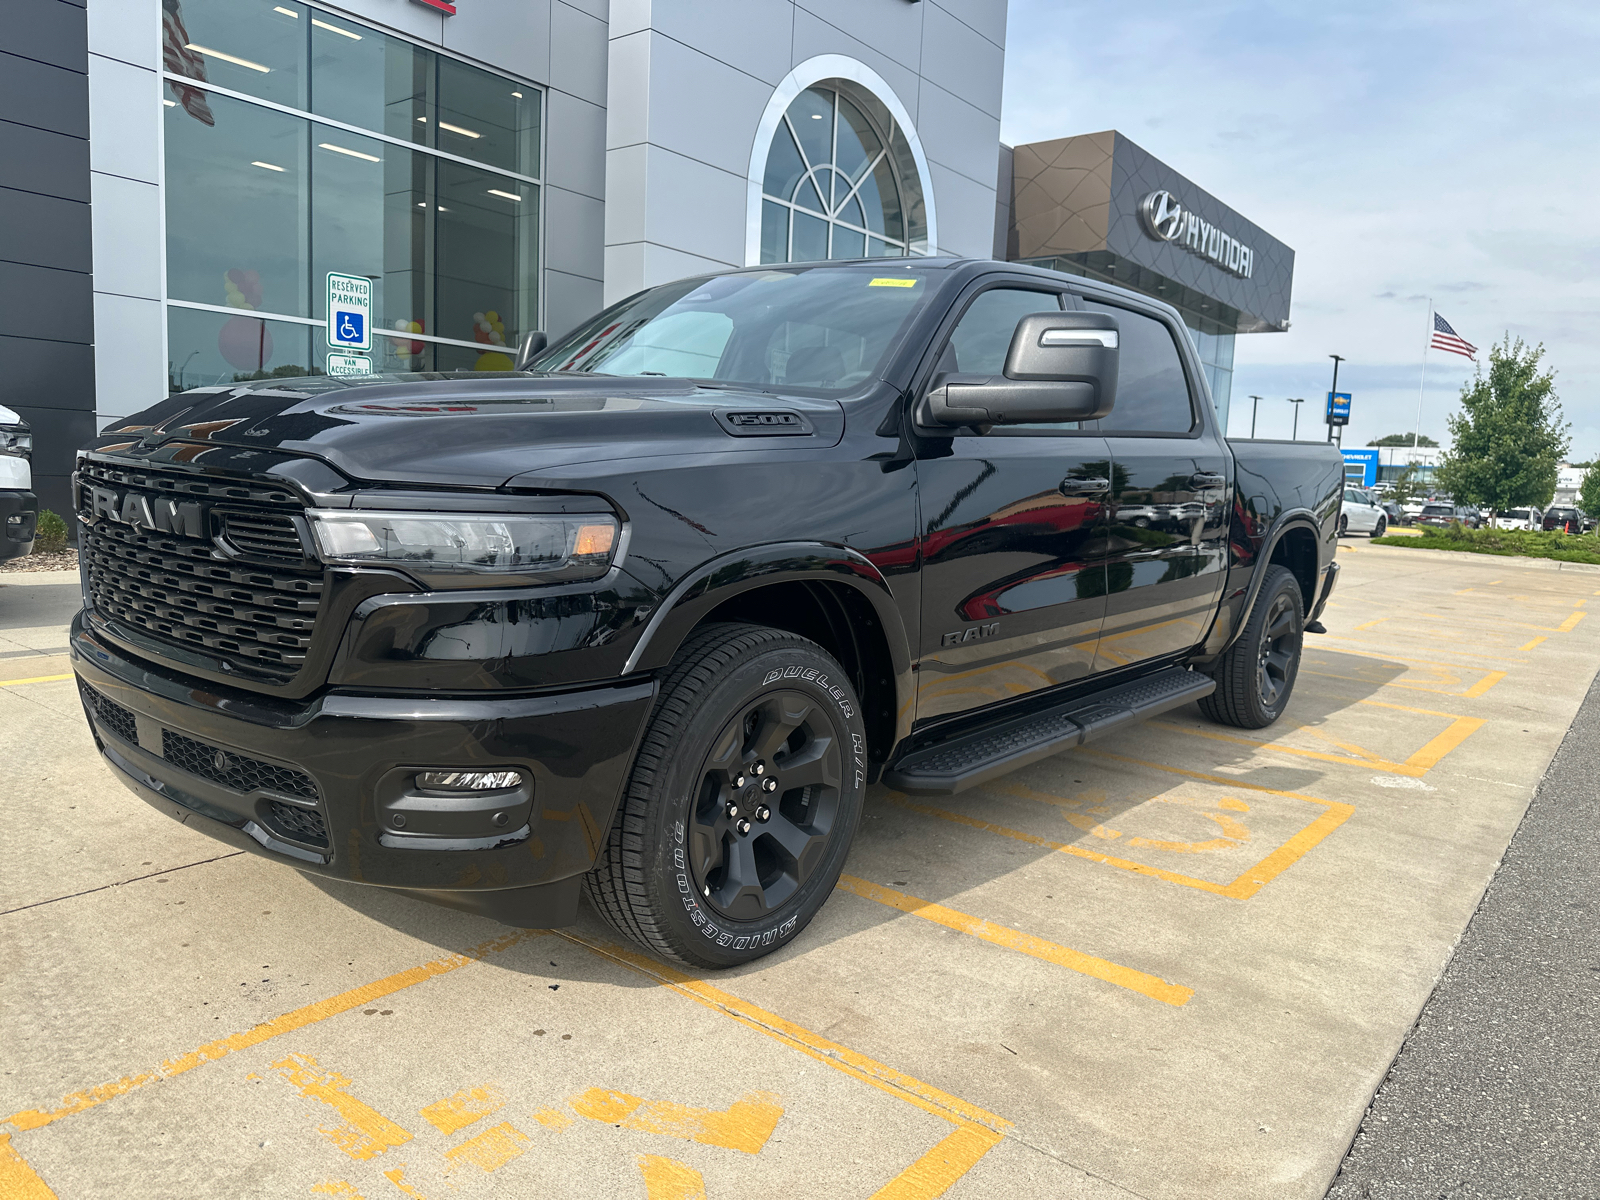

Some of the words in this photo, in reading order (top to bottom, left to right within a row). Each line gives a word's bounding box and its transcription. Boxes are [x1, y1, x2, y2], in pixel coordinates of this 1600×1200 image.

[1184, 211, 1253, 278] HYUNDAI
[331, 280, 368, 295] RESERVED
[331, 293, 368, 307] PARKING
[330, 366, 369, 375] ACCESSIBLE
[343, 358, 357, 367] VAN
[729, 414, 798, 426] 1500
[91, 486, 203, 539] RAM
[940, 622, 1000, 647] RAM
[762, 665, 854, 719] DUELER
[674, 821, 798, 950] BRIDGESTONE
